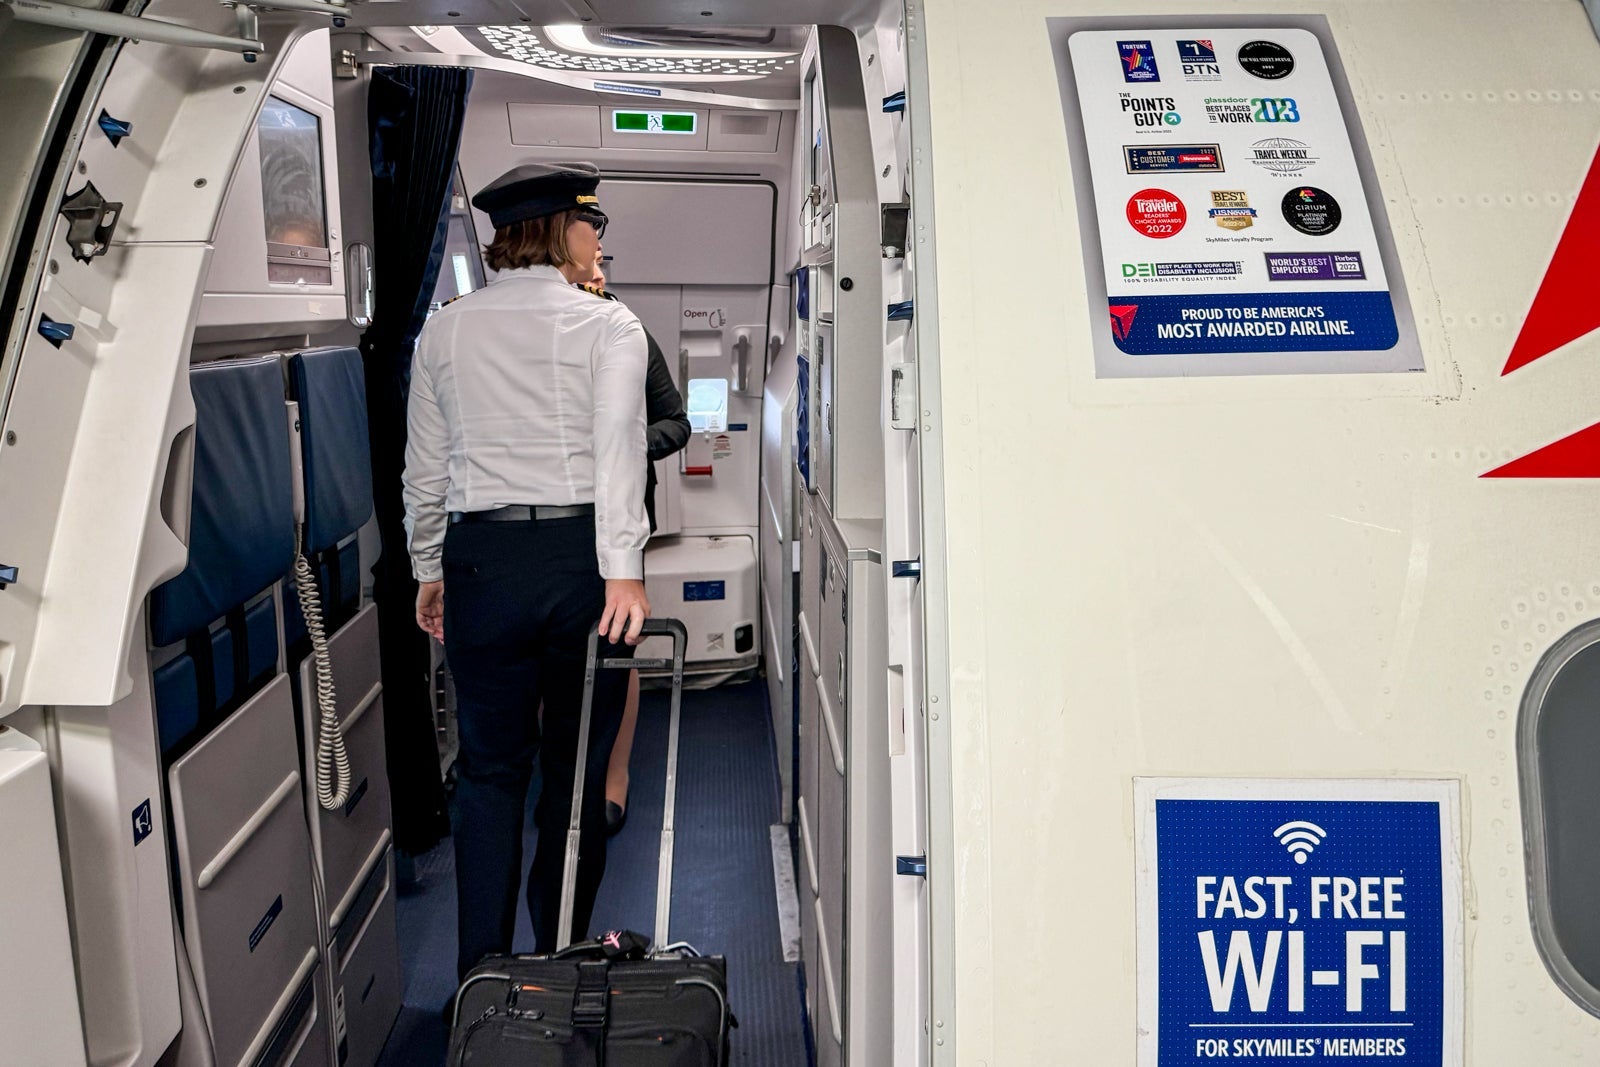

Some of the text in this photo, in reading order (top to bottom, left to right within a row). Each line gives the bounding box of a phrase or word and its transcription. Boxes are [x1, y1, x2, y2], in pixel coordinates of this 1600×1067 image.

[1182, 65, 1220, 74] BTN
[1121, 98, 1176, 112] POINTS
[1251, 98, 1301, 123] 2023
[1134, 112, 1163, 126] GUY
[1218, 113, 1254, 123] WORK
[1253, 150, 1308, 159] TRAVEL WEEKLY
[1213, 192, 1245, 201] BEST
[1135, 198, 1178, 213] Traveler
[1122, 263, 1156, 277] DEI
[684, 310, 707, 318] Open
[1181, 306, 1324, 320] PROUD TO BE AMERICA'S
[1158, 320, 1355, 338] MOST AWARDED AIRLINE.
[1196, 876, 1406, 924] FAST, FREE
[1197, 930, 1406, 1012] WI-FI
[1196, 1039, 1229, 1057] FOR
[1324, 1038, 1406, 1056] MEMBERS
